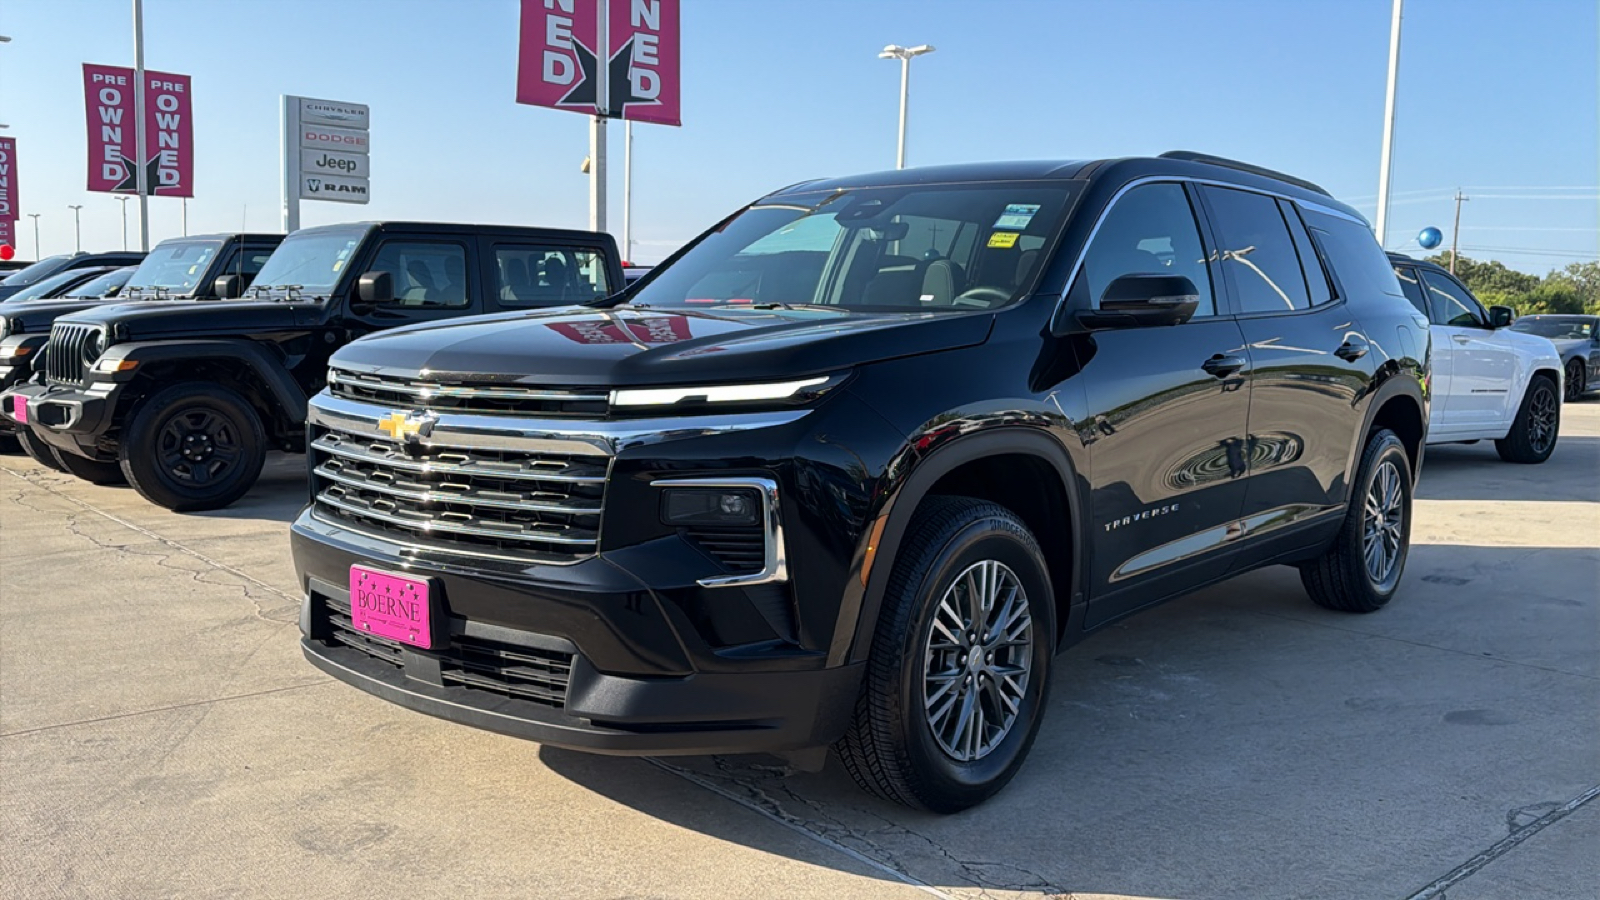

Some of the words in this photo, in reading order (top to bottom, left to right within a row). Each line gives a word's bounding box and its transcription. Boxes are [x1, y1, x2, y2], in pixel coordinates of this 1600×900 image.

[92, 73, 127, 86] PRE
[150, 80, 185, 92] PRE
[306, 104, 365, 116] CHRYSLER
[98, 87, 124, 181] OWNED
[155, 94, 181, 185] OWNED
[305, 132, 367, 146] DODGE
[315, 154, 357, 173] Jeep
[324, 183, 367, 195] RAM
[1104, 503, 1180, 532] TRAVERSE
[989, 518, 1040, 555] BRIDGESTON
[357, 589, 421, 622] BOERNE
